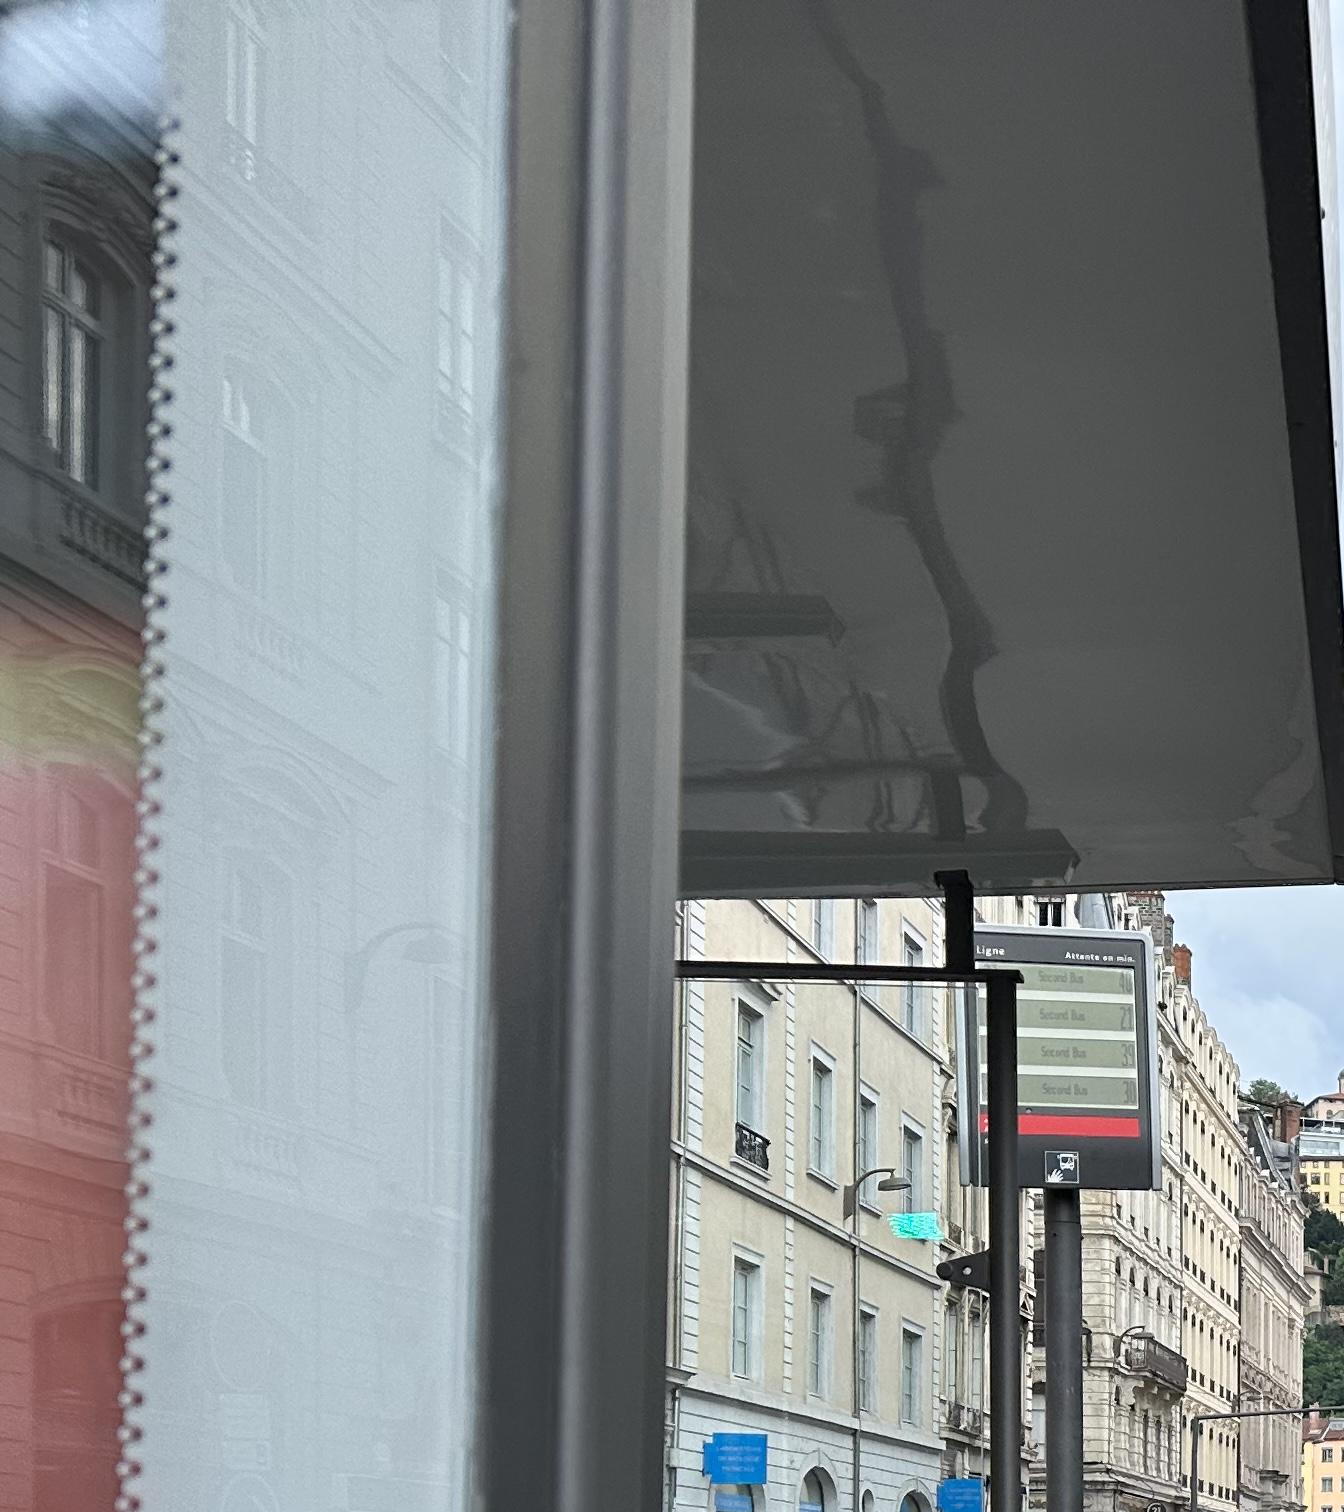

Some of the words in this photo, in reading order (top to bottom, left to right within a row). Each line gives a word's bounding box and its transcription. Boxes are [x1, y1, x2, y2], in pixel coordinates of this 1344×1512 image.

[976, 945, 1005, 957] Ligne
[1065, 951, 1100, 961] Attente
[1071, 1008, 1085, 1021] Bus
[1072, 1046, 1087, 1058] Bus
[1074, 1084, 1089, 1096] Bus
